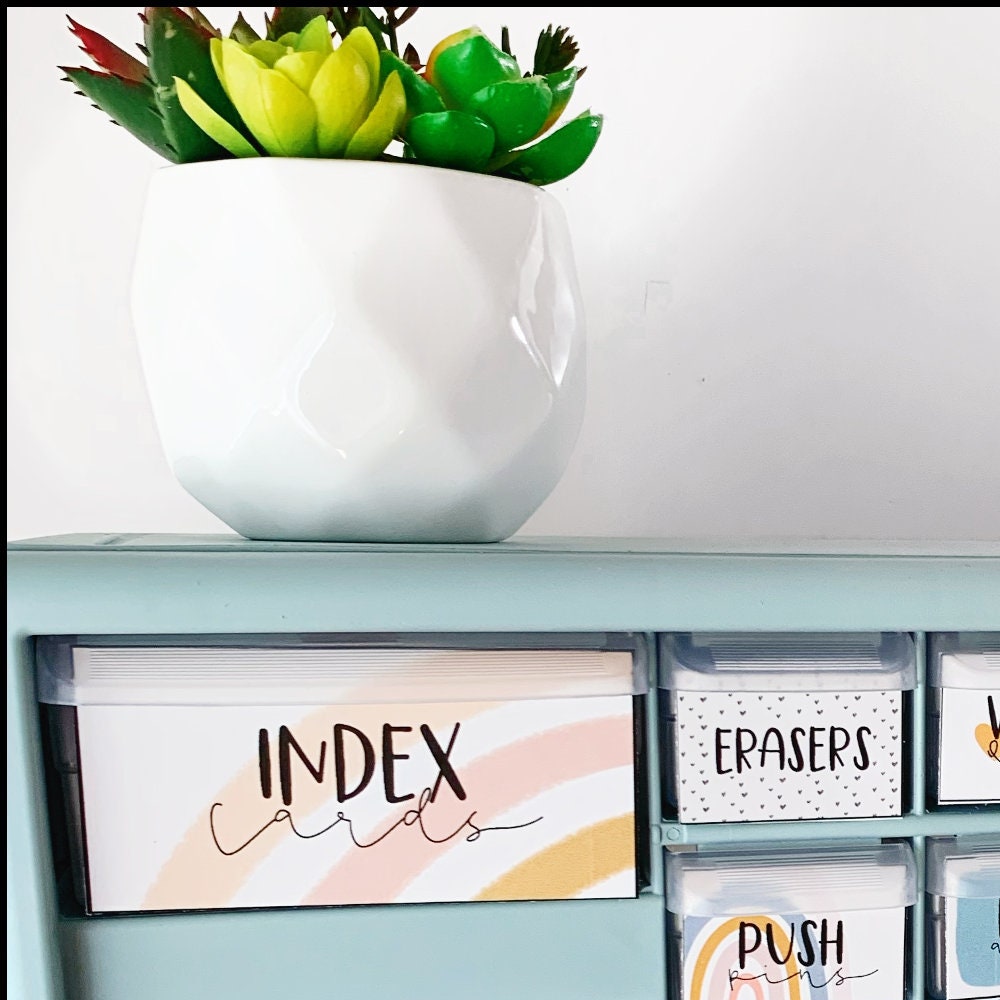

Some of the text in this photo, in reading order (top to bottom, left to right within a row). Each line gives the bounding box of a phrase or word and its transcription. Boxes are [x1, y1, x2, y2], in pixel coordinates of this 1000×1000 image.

[259, 722, 466, 805] INDEX
[715, 726, 872, 774] ERASERS
[210, 788, 543, 855] cards
[738, 919, 843, 969] PUSH
[729, 964, 878, 991] pins
